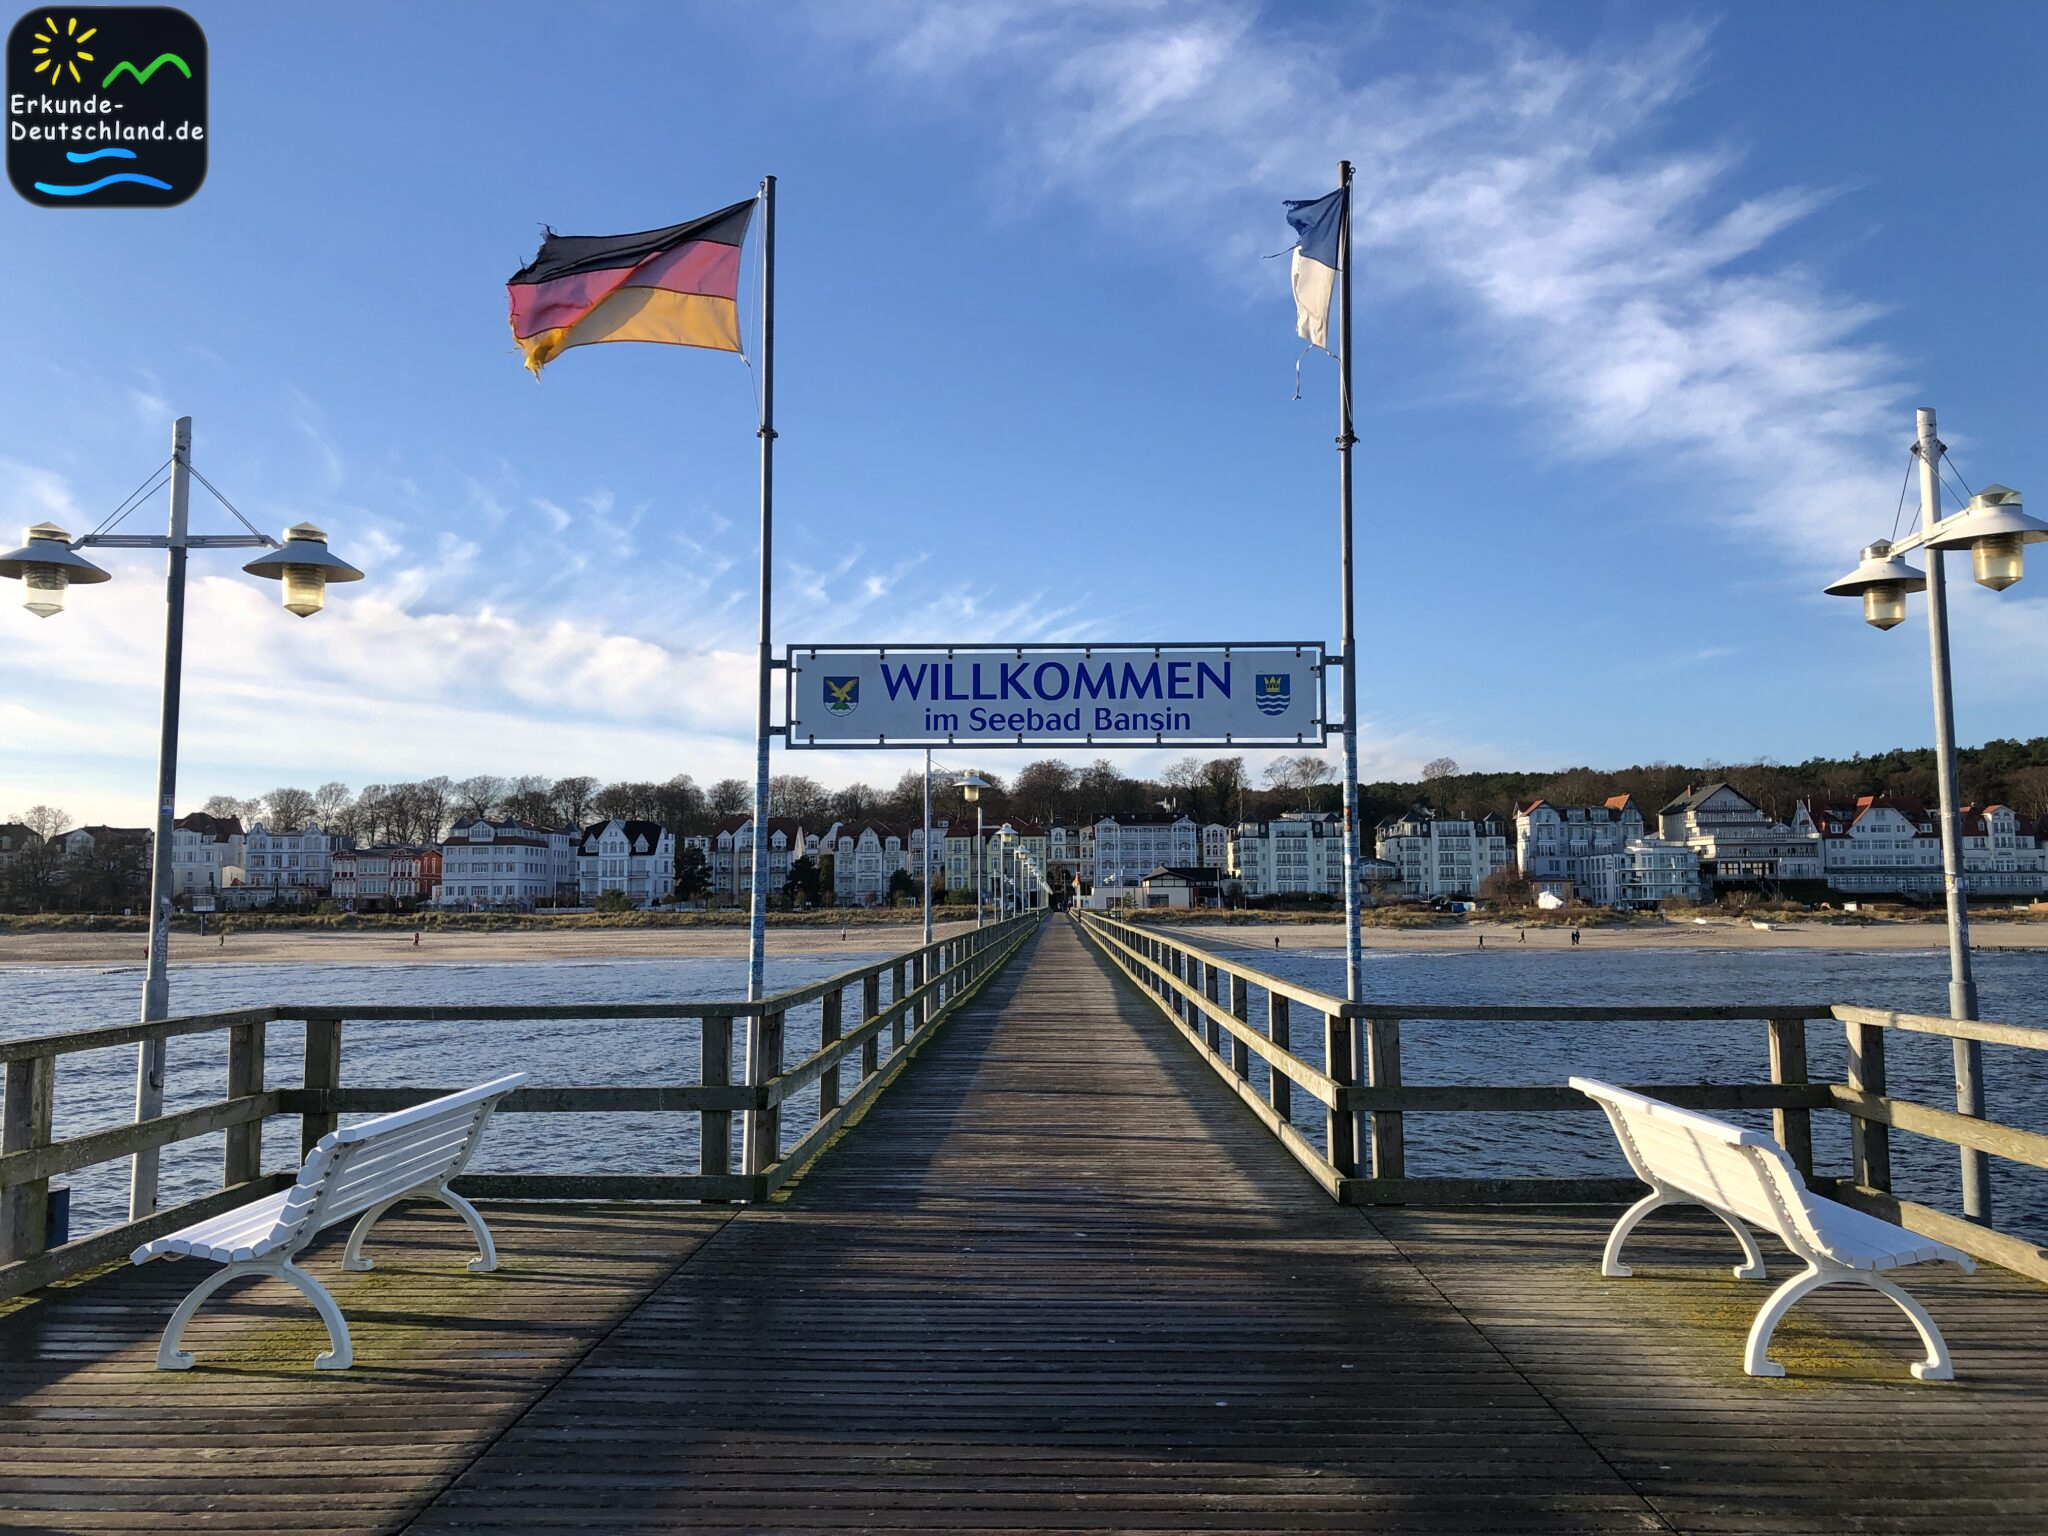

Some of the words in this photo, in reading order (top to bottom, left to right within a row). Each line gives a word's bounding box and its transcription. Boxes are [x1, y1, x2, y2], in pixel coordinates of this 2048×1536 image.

[879, 661, 1231, 701] WILLKOMMEN
[925, 707, 959, 731] im
[968, 707, 1081, 732] Seebad
[1094, 706, 1191, 731] Bansin
